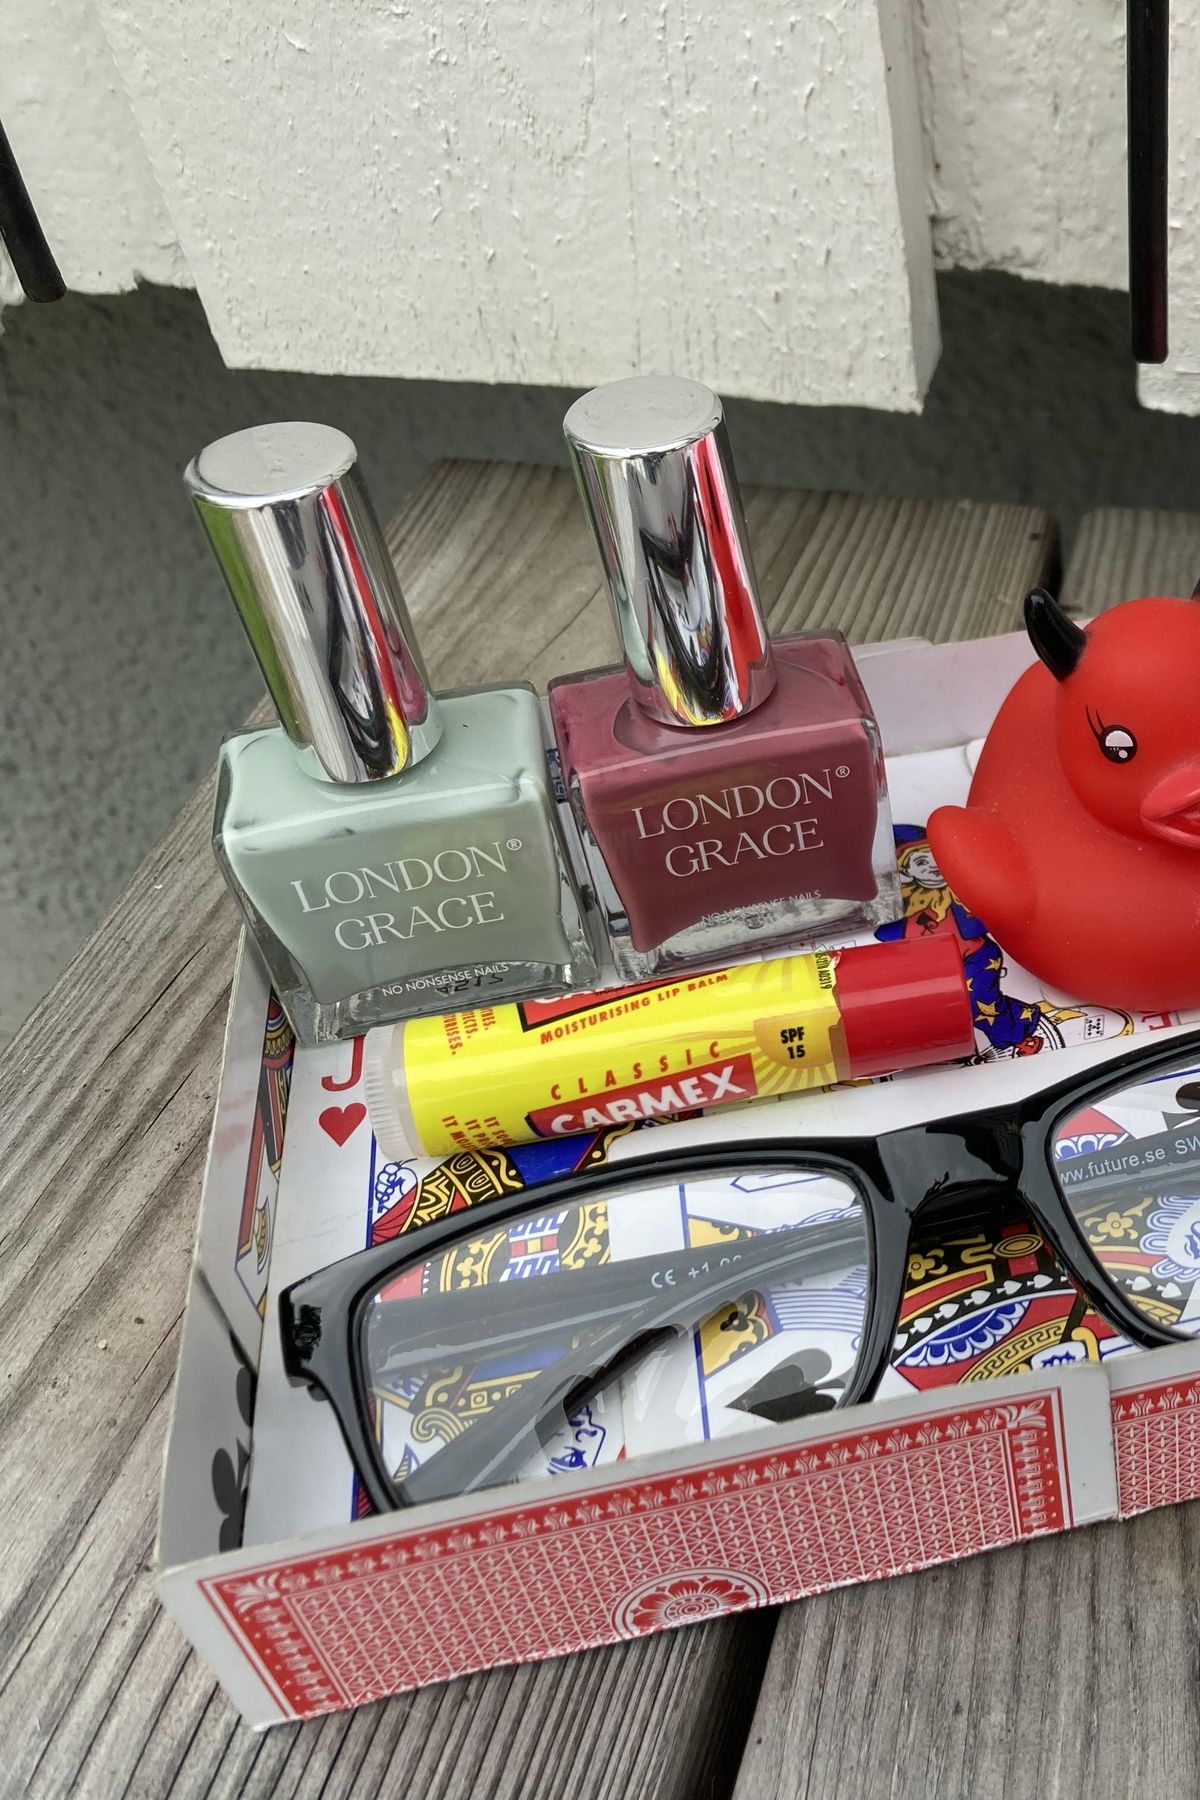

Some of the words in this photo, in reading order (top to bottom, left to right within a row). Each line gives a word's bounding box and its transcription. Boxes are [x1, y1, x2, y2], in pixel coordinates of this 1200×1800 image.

[665, 818, 824, 877] GRACE
[335, 891, 505, 950] GRACE
[382, 985, 403, 997] NO
[405, 969, 473, 992] NONSENSE
[474, 963, 509, 979] NAILS
[540, 997, 651, 1045] MOISTURISING
[657, 987, 681, 1002] LIP
[687, 973, 728, 992] BALM
[321, 1036, 364, 1092] J
[780, 1026, 805, 1044] SPF
[787, 1044, 806, 1060] 15
[550, 1041, 720, 1100] CLASSIC
[551, 1065, 747, 1134] CARMEX
